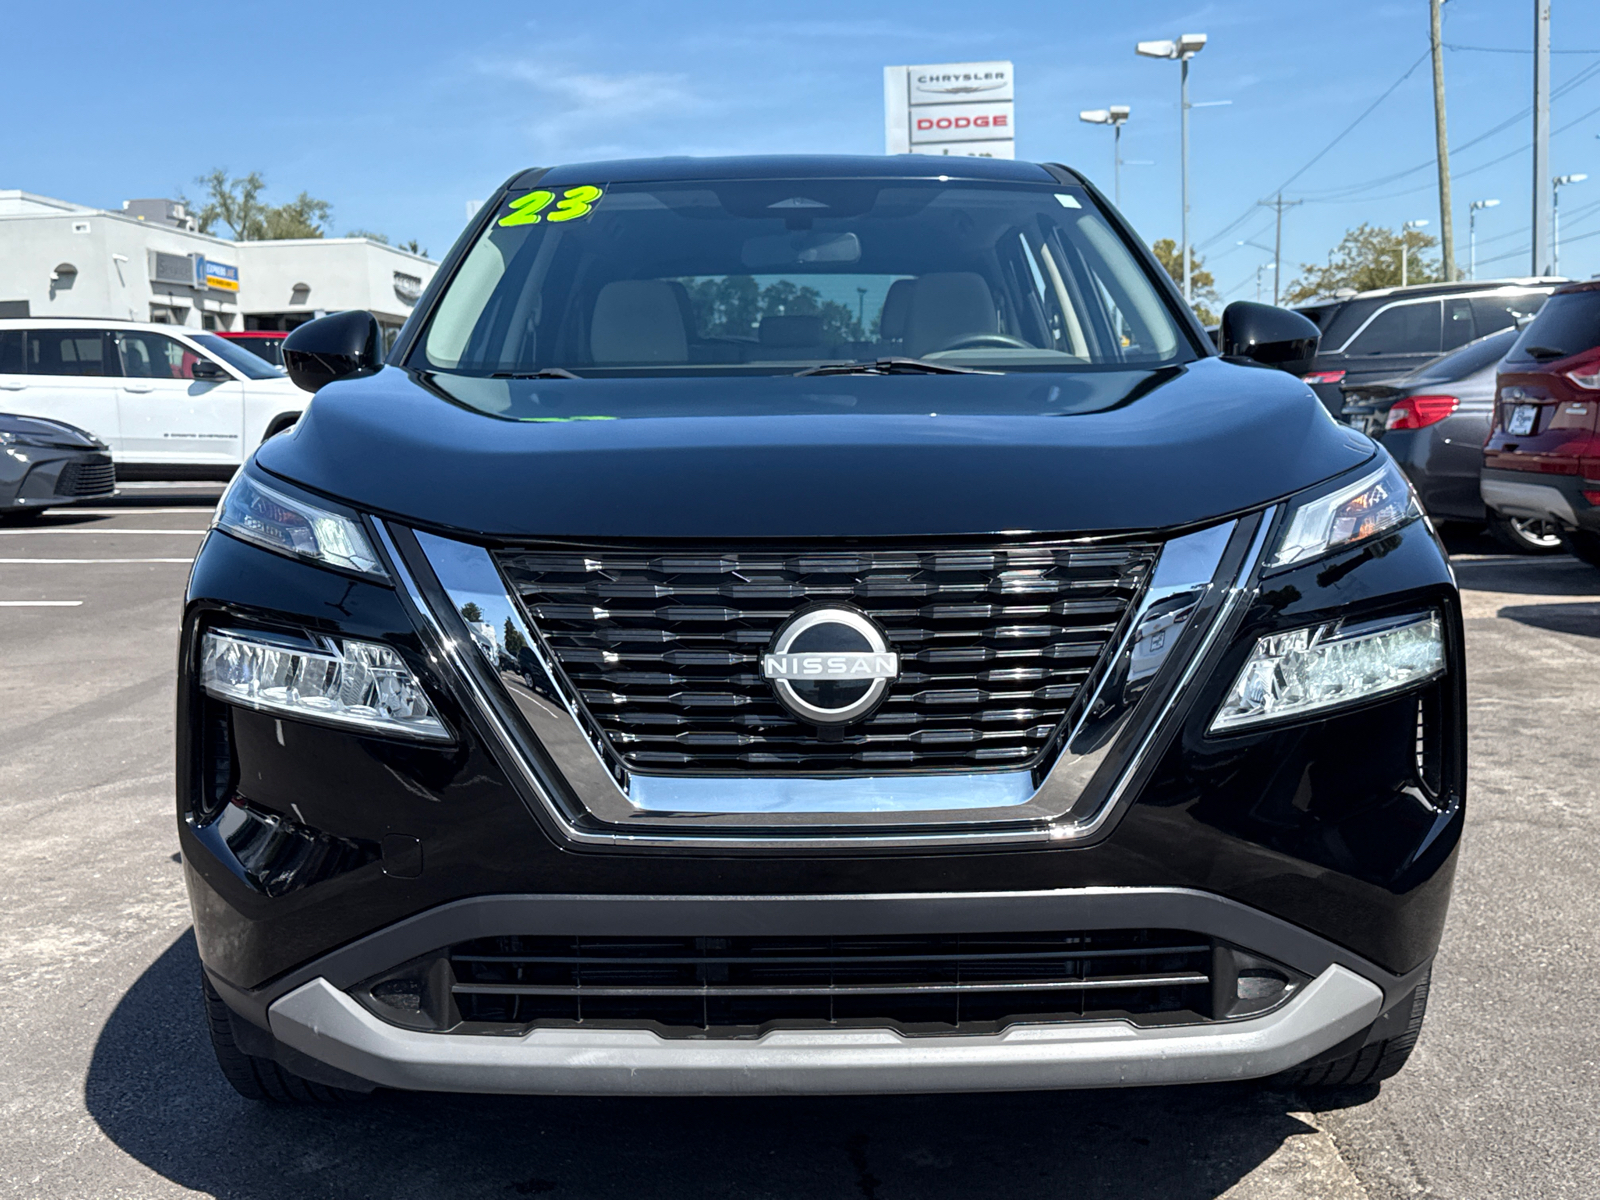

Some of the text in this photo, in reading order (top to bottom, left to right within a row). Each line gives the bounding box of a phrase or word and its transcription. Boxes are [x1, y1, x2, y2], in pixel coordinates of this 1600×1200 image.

[917, 72, 1005, 84] CHRYSLER
[916, 115, 1008, 131] DODGE
[498, 185, 603, 227] 23
[767, 656, 894, 675] NISSAN
